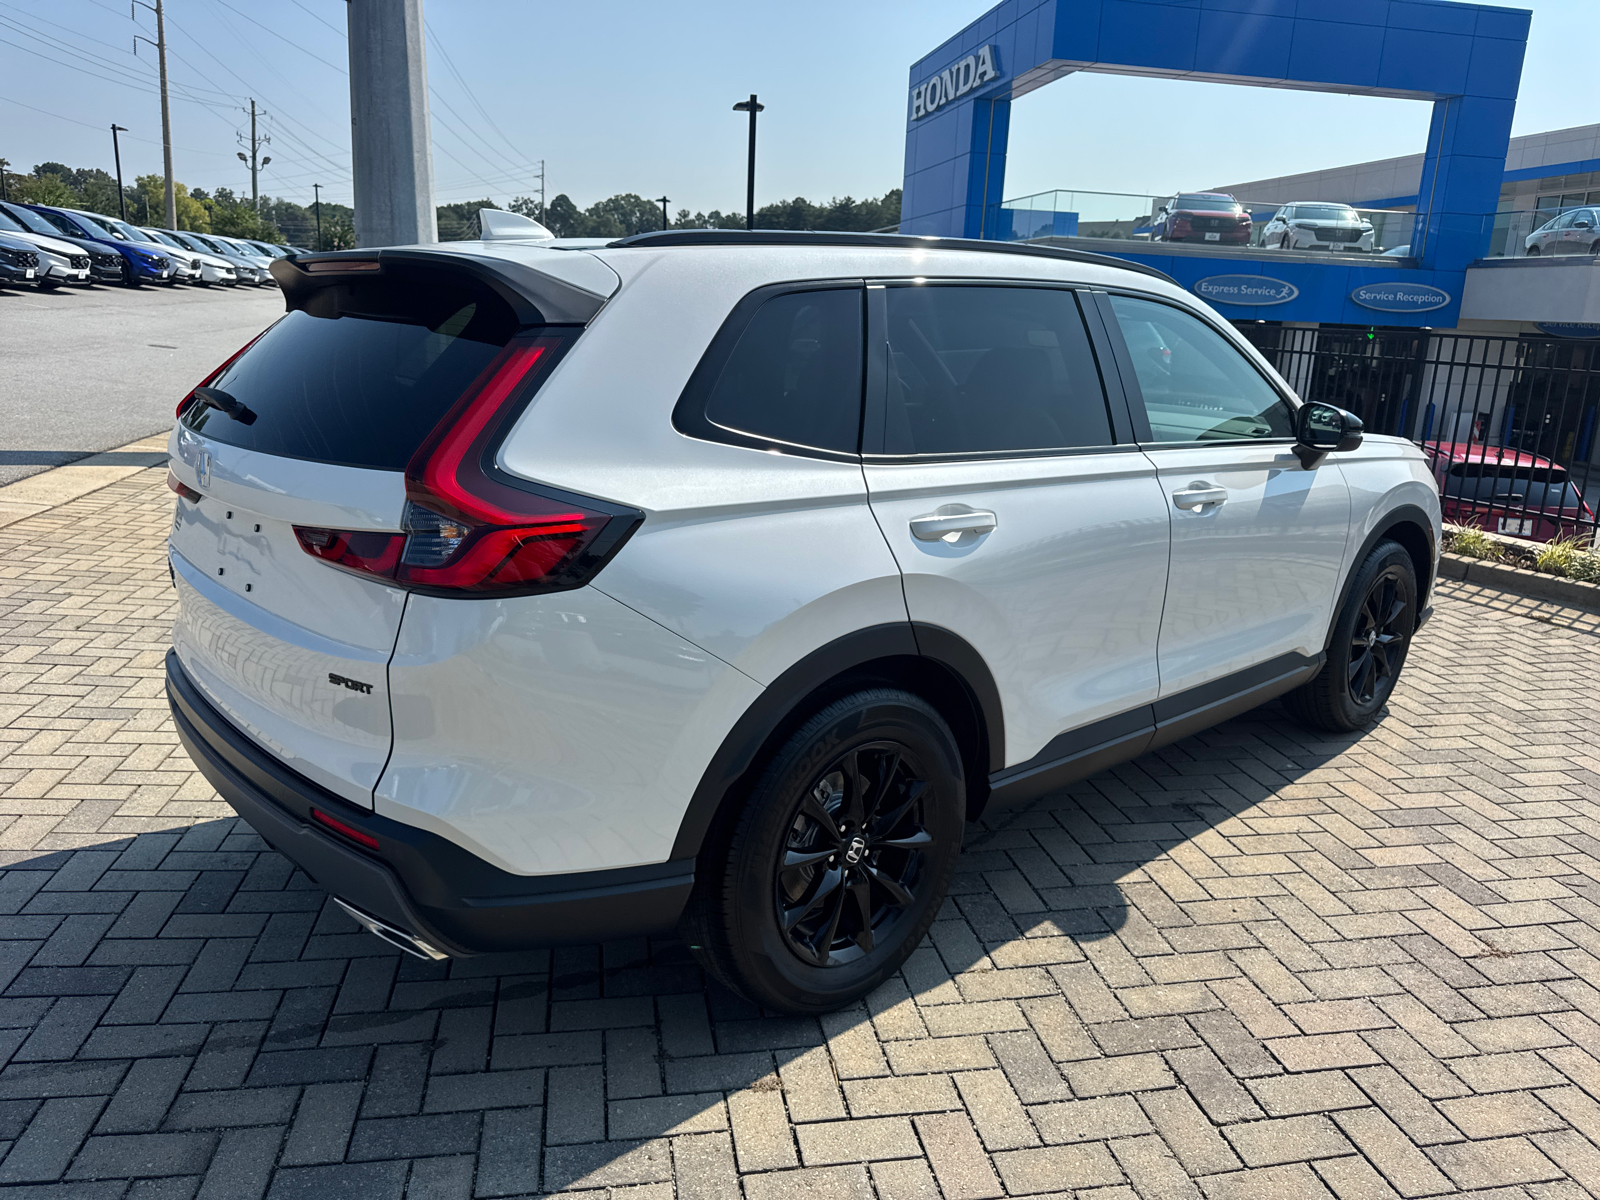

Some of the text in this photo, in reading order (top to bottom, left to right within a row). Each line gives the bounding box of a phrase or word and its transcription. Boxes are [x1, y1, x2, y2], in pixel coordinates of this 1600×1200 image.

[910, 44, 998, 121] HONDA
[1201, 282, 1276, 296] Express Service
[1359, 290, 1443, 304] Service Reception
[328, 672, 374, 695] SPORT
